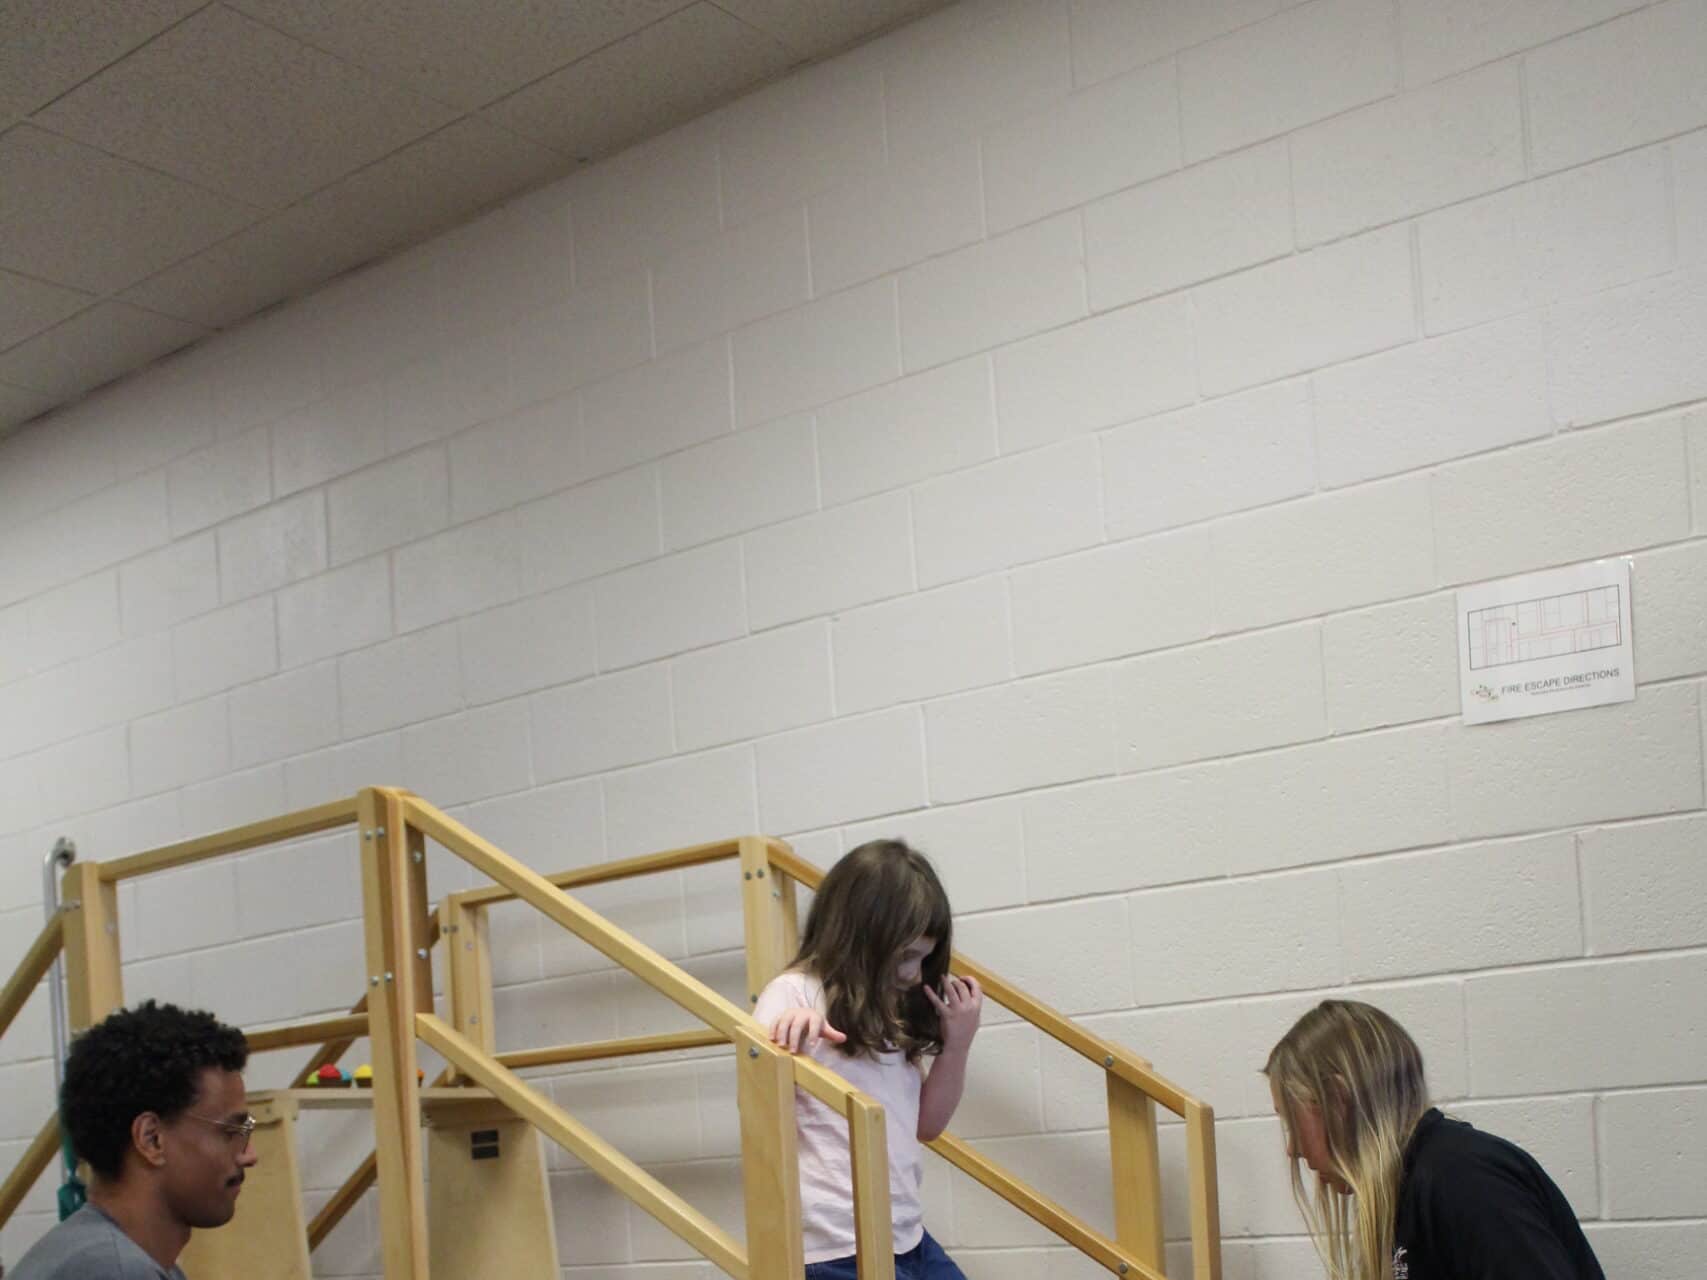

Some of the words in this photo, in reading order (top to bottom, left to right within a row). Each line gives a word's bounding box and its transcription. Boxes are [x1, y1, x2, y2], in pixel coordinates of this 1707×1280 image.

[1501, 682, 1521, 695] FIRE
[1524, 677, 1561, 690] ESCAPE
[1563, 668, 1620, 685] DIRECTIONS
